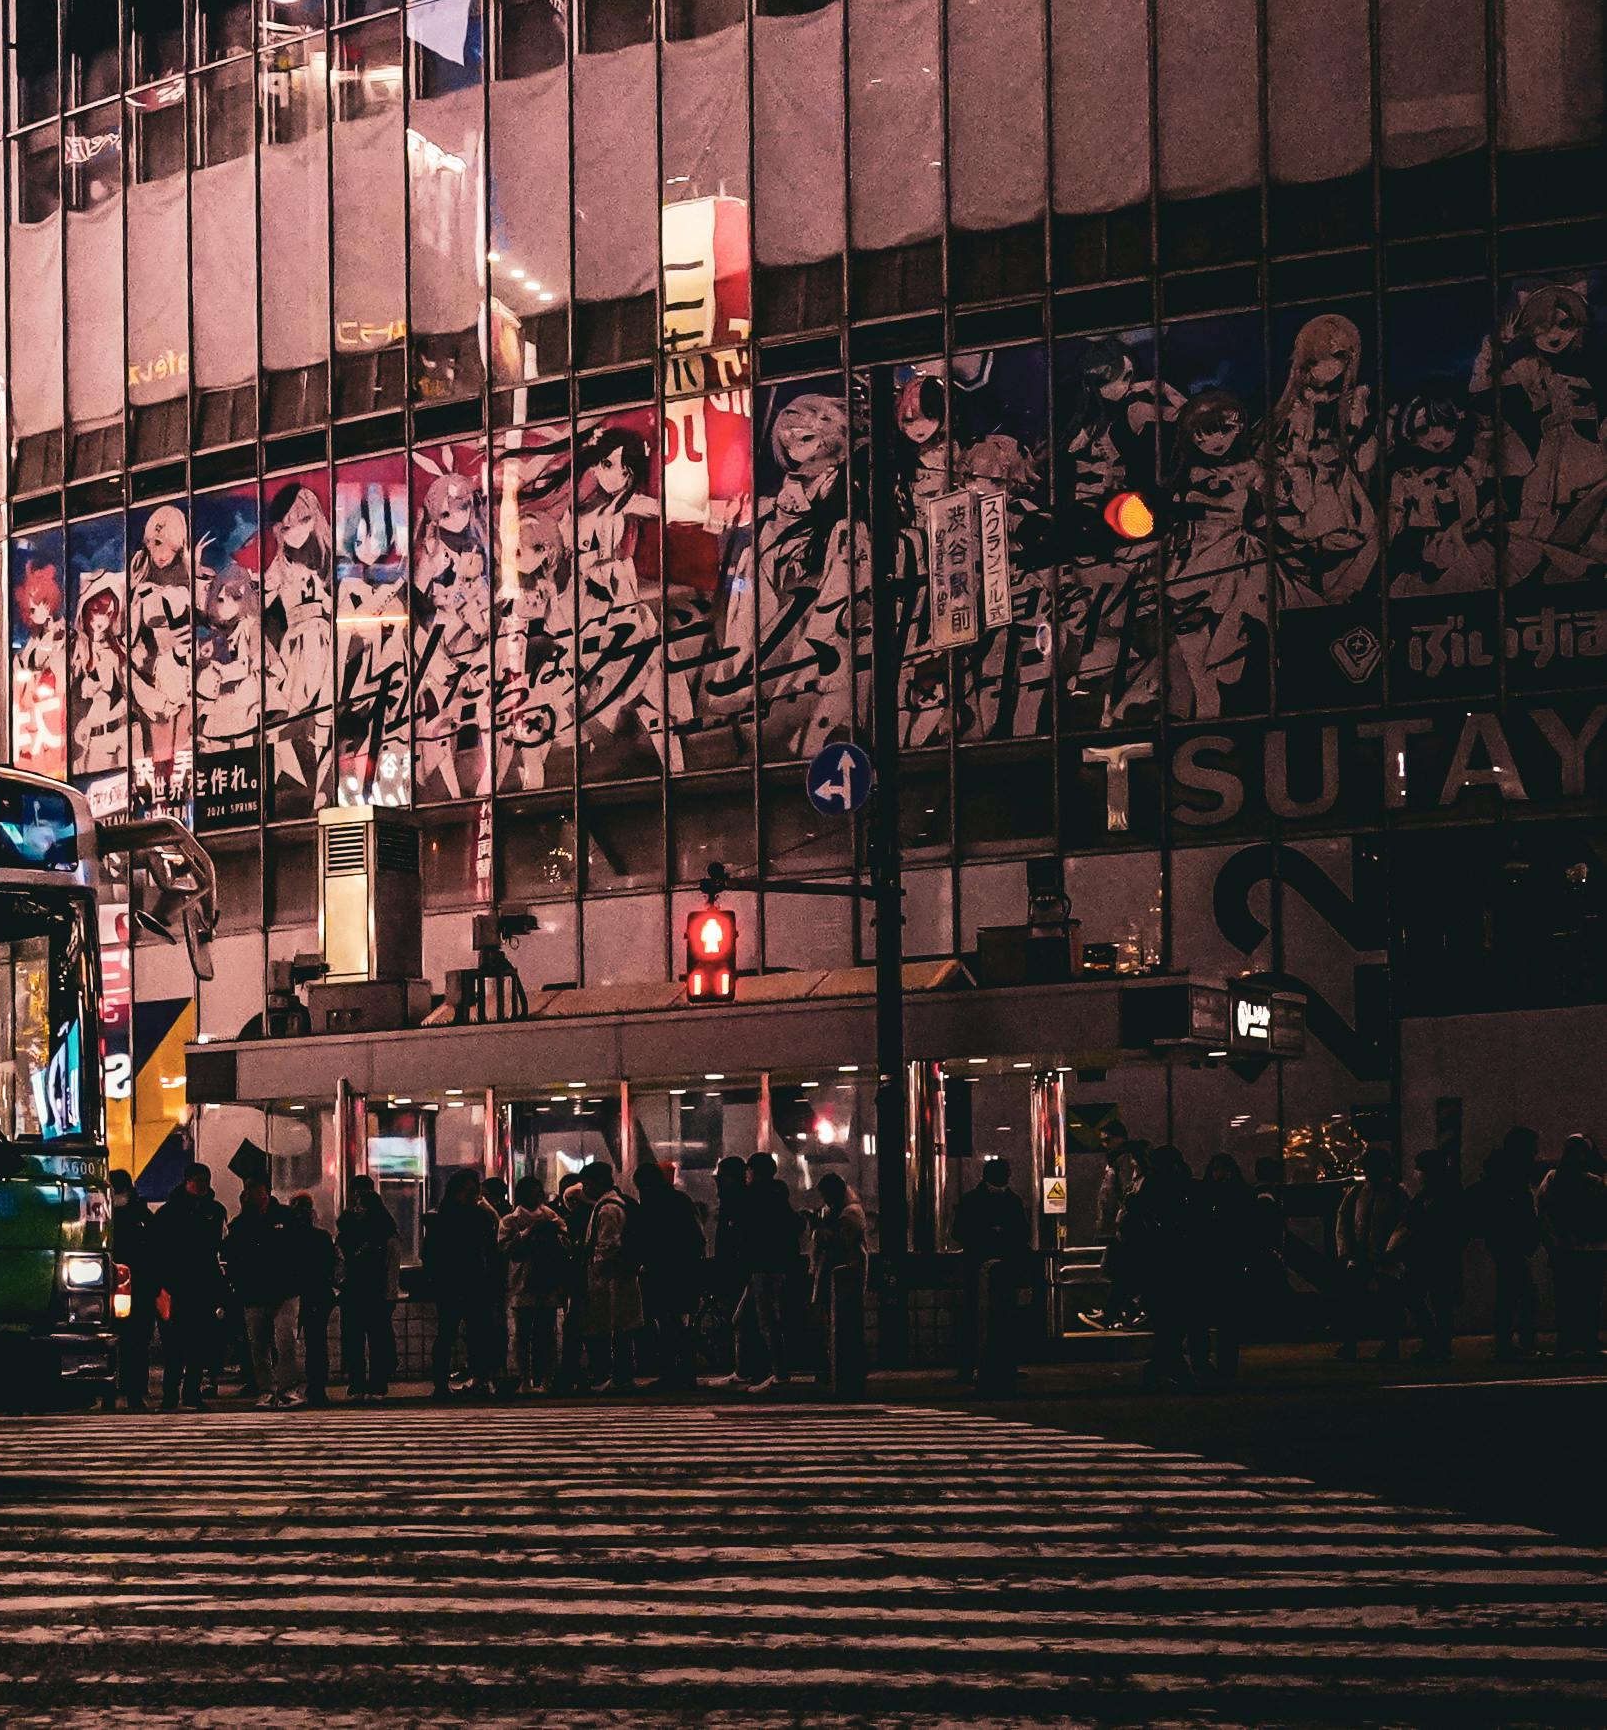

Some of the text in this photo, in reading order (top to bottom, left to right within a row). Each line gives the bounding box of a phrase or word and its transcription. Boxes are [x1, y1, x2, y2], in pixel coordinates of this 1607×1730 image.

[944, 503, 972, 634] 渋谷駅前
[230, 801, 258, 814] SPRING
